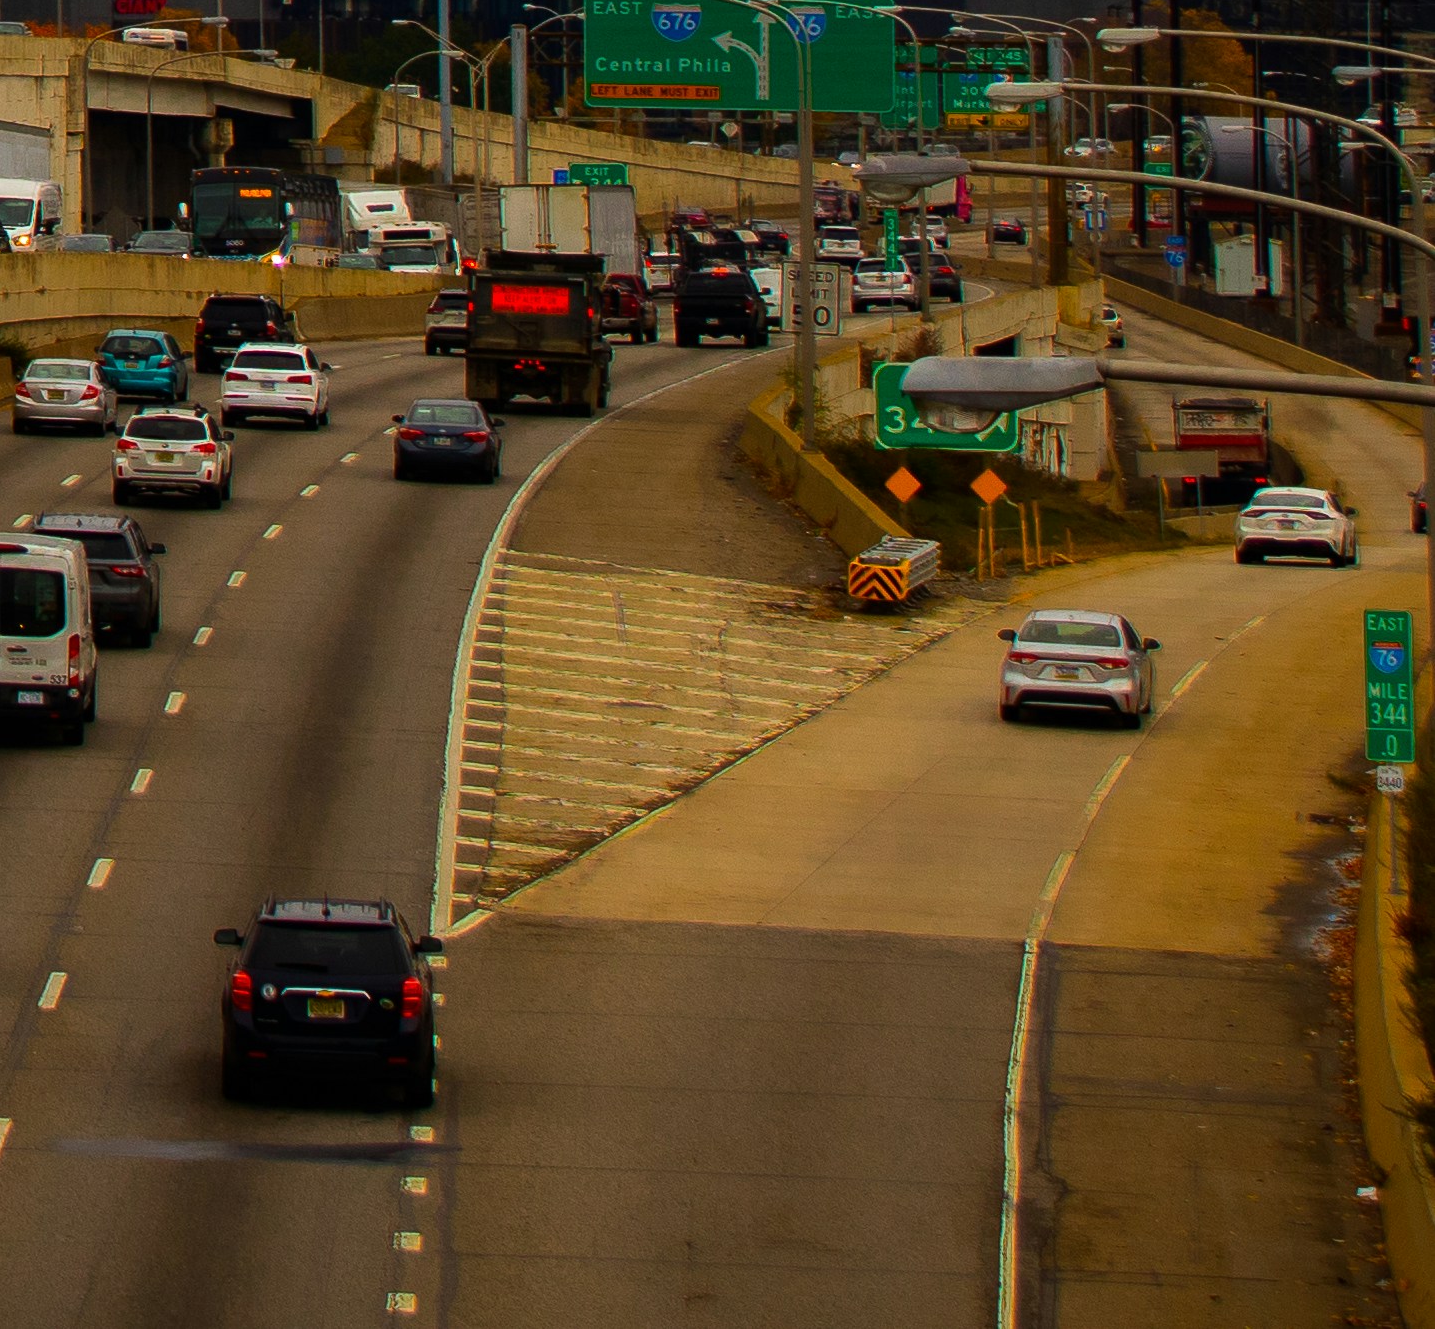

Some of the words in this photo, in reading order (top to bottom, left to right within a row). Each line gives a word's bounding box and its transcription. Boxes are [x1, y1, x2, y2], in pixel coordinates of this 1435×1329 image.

[593, 1, 642, 15] EAST
[658, 13, 697, 30] 676
[596, 57, 671, 72] Central
[679, 57, 732, 73] Phila
[591, 84, 618, 96] LEFT
[624, 85, 655, 97] LANE
[660, 86, 691, 98] MUST
[695, 87, 720, 99] EXIT
[1000, 118, 1024, 126] ONLY
[584, 166, 609, 176] EXIT
[1169, 251, 1184, 263] 76
[1367, 614, 1405, 632] EAST
[1377, 649, 1397, 667] 76
[49, 674, 67, 685] 537
[1367, 682, 1408, 700] MILE
[1371, 702, 1408, 725] 344
[1381, 734, 1398, 757] .0
